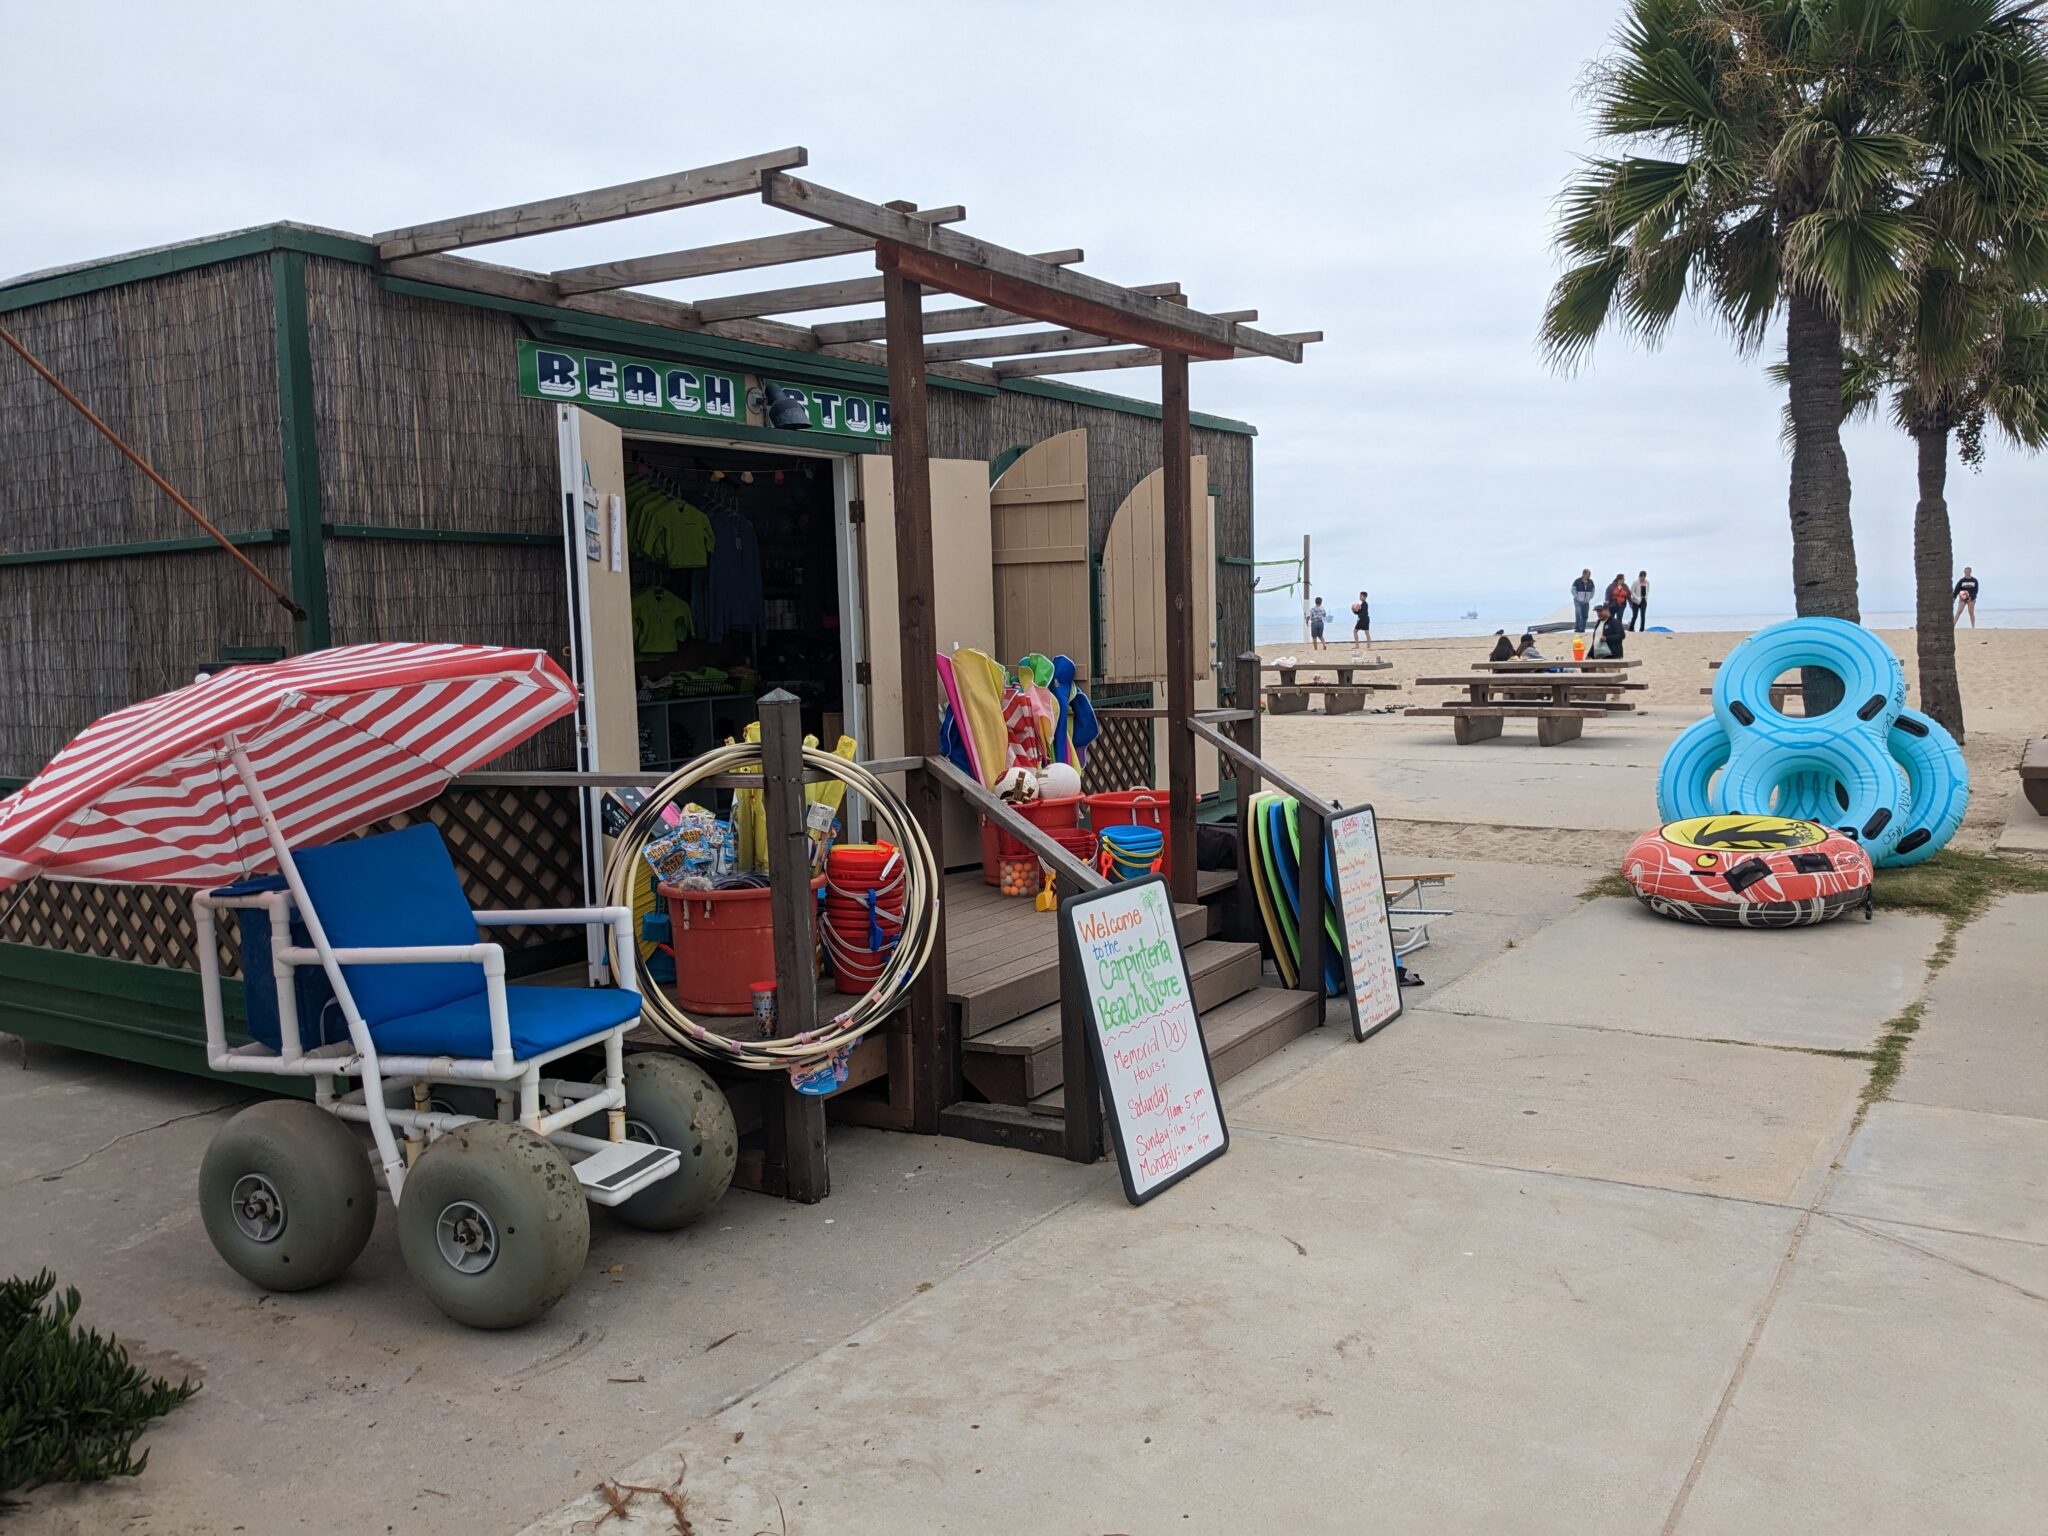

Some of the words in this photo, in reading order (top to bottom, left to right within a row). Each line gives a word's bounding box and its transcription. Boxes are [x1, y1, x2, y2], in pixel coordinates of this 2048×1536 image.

[536, 350, 736, 418] BEACH
[781, 387, 891, 436] TOR
[1077, 909, 1142, 943] Welcome
[1093, 944, 1104, 960] to
[1104, 940, 1120, 957] the
[1098, 937, 1173, 991] Carpinteria
[1097, 981, 1147, 1031] Beach
[1142, 970, 1182, 1014] Store
[1113, 1025, 1160, 1076] Memorial
[1160, 1016, 1188, 1053] Day
